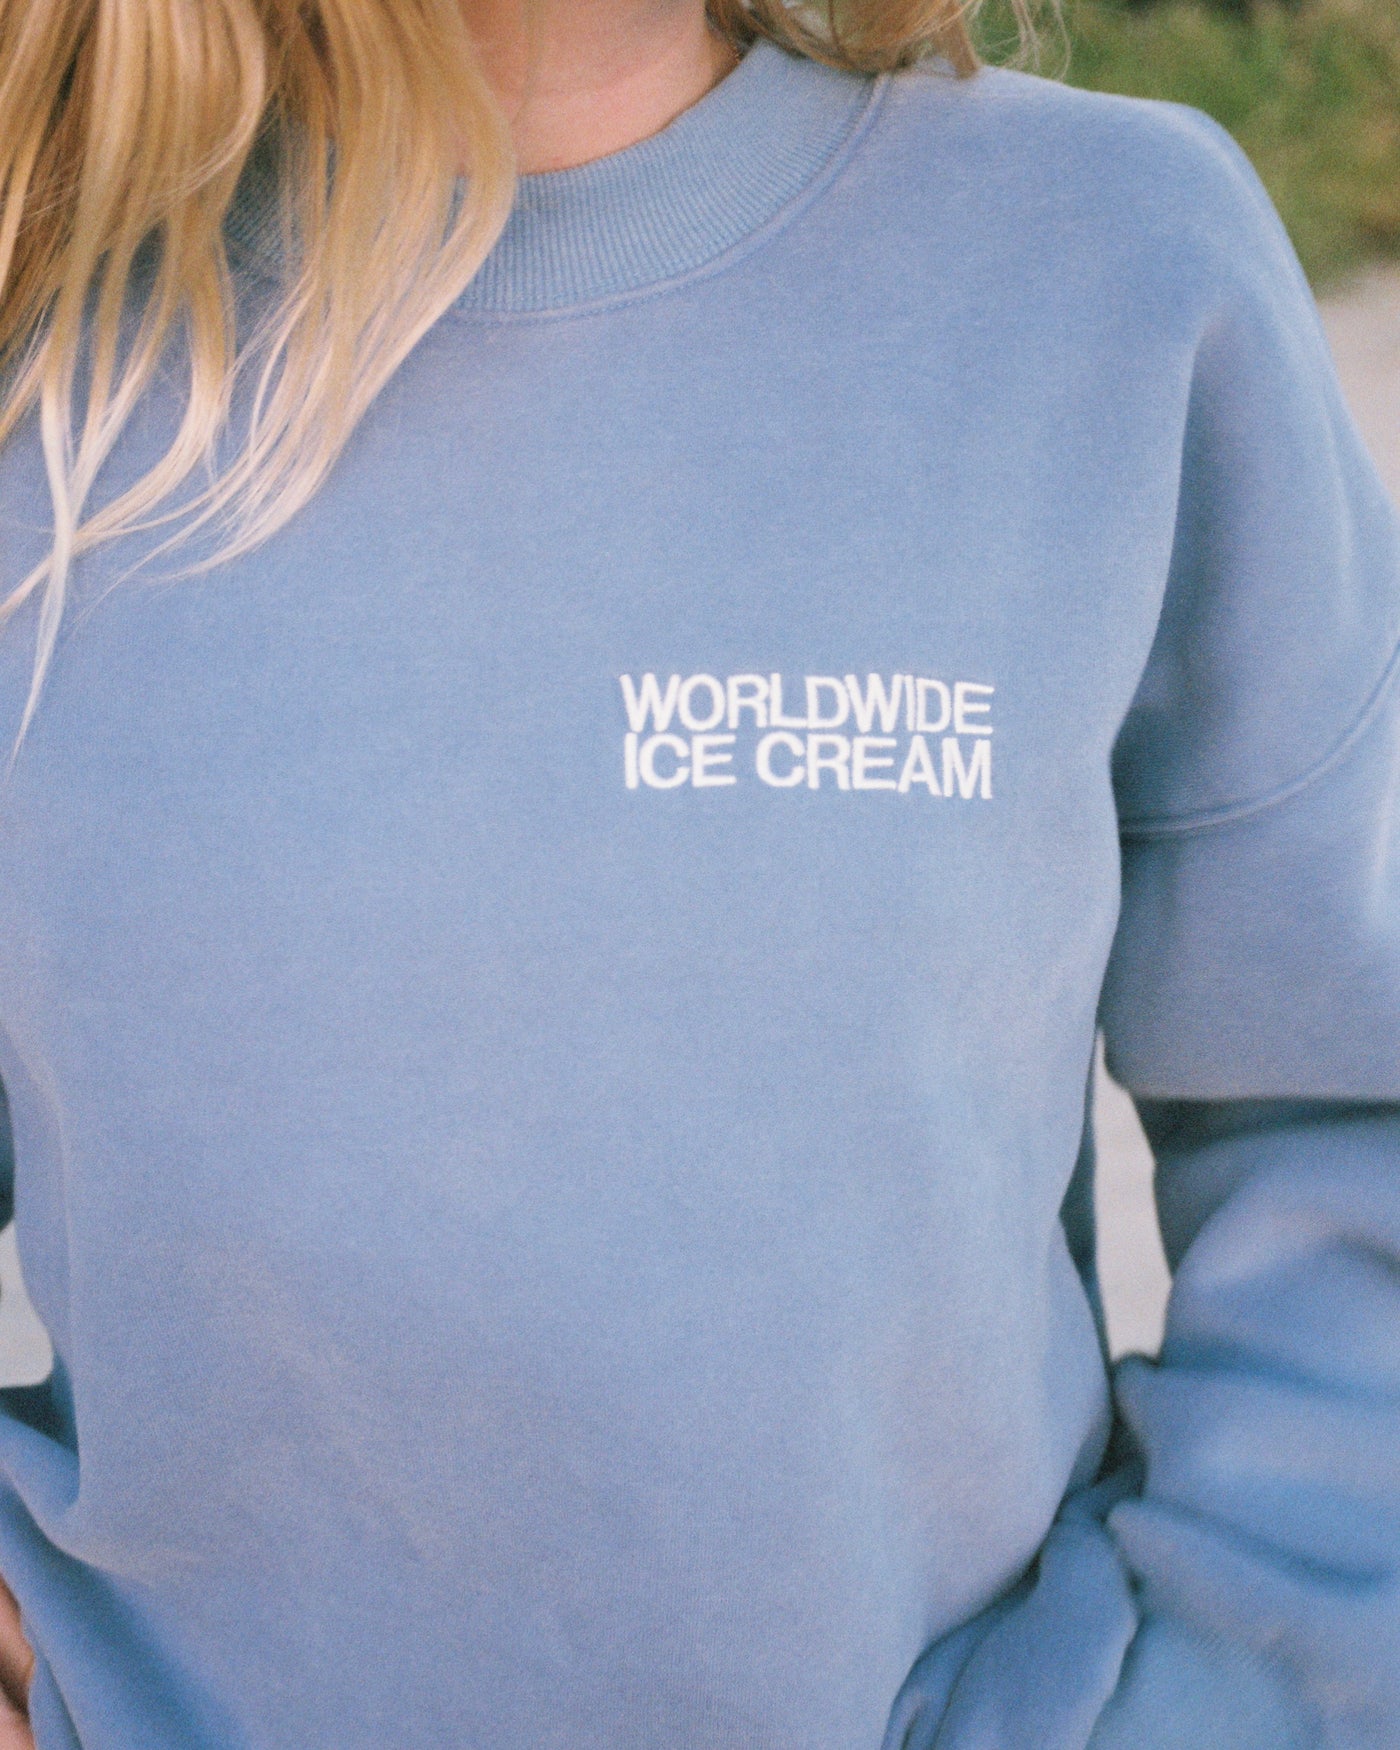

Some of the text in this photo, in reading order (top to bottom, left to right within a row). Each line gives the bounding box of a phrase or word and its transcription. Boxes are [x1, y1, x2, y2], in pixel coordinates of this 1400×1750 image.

[619, 672, 995, 735] WORLDWIDE
[624, 731, 993, 800] ICE CREAM
